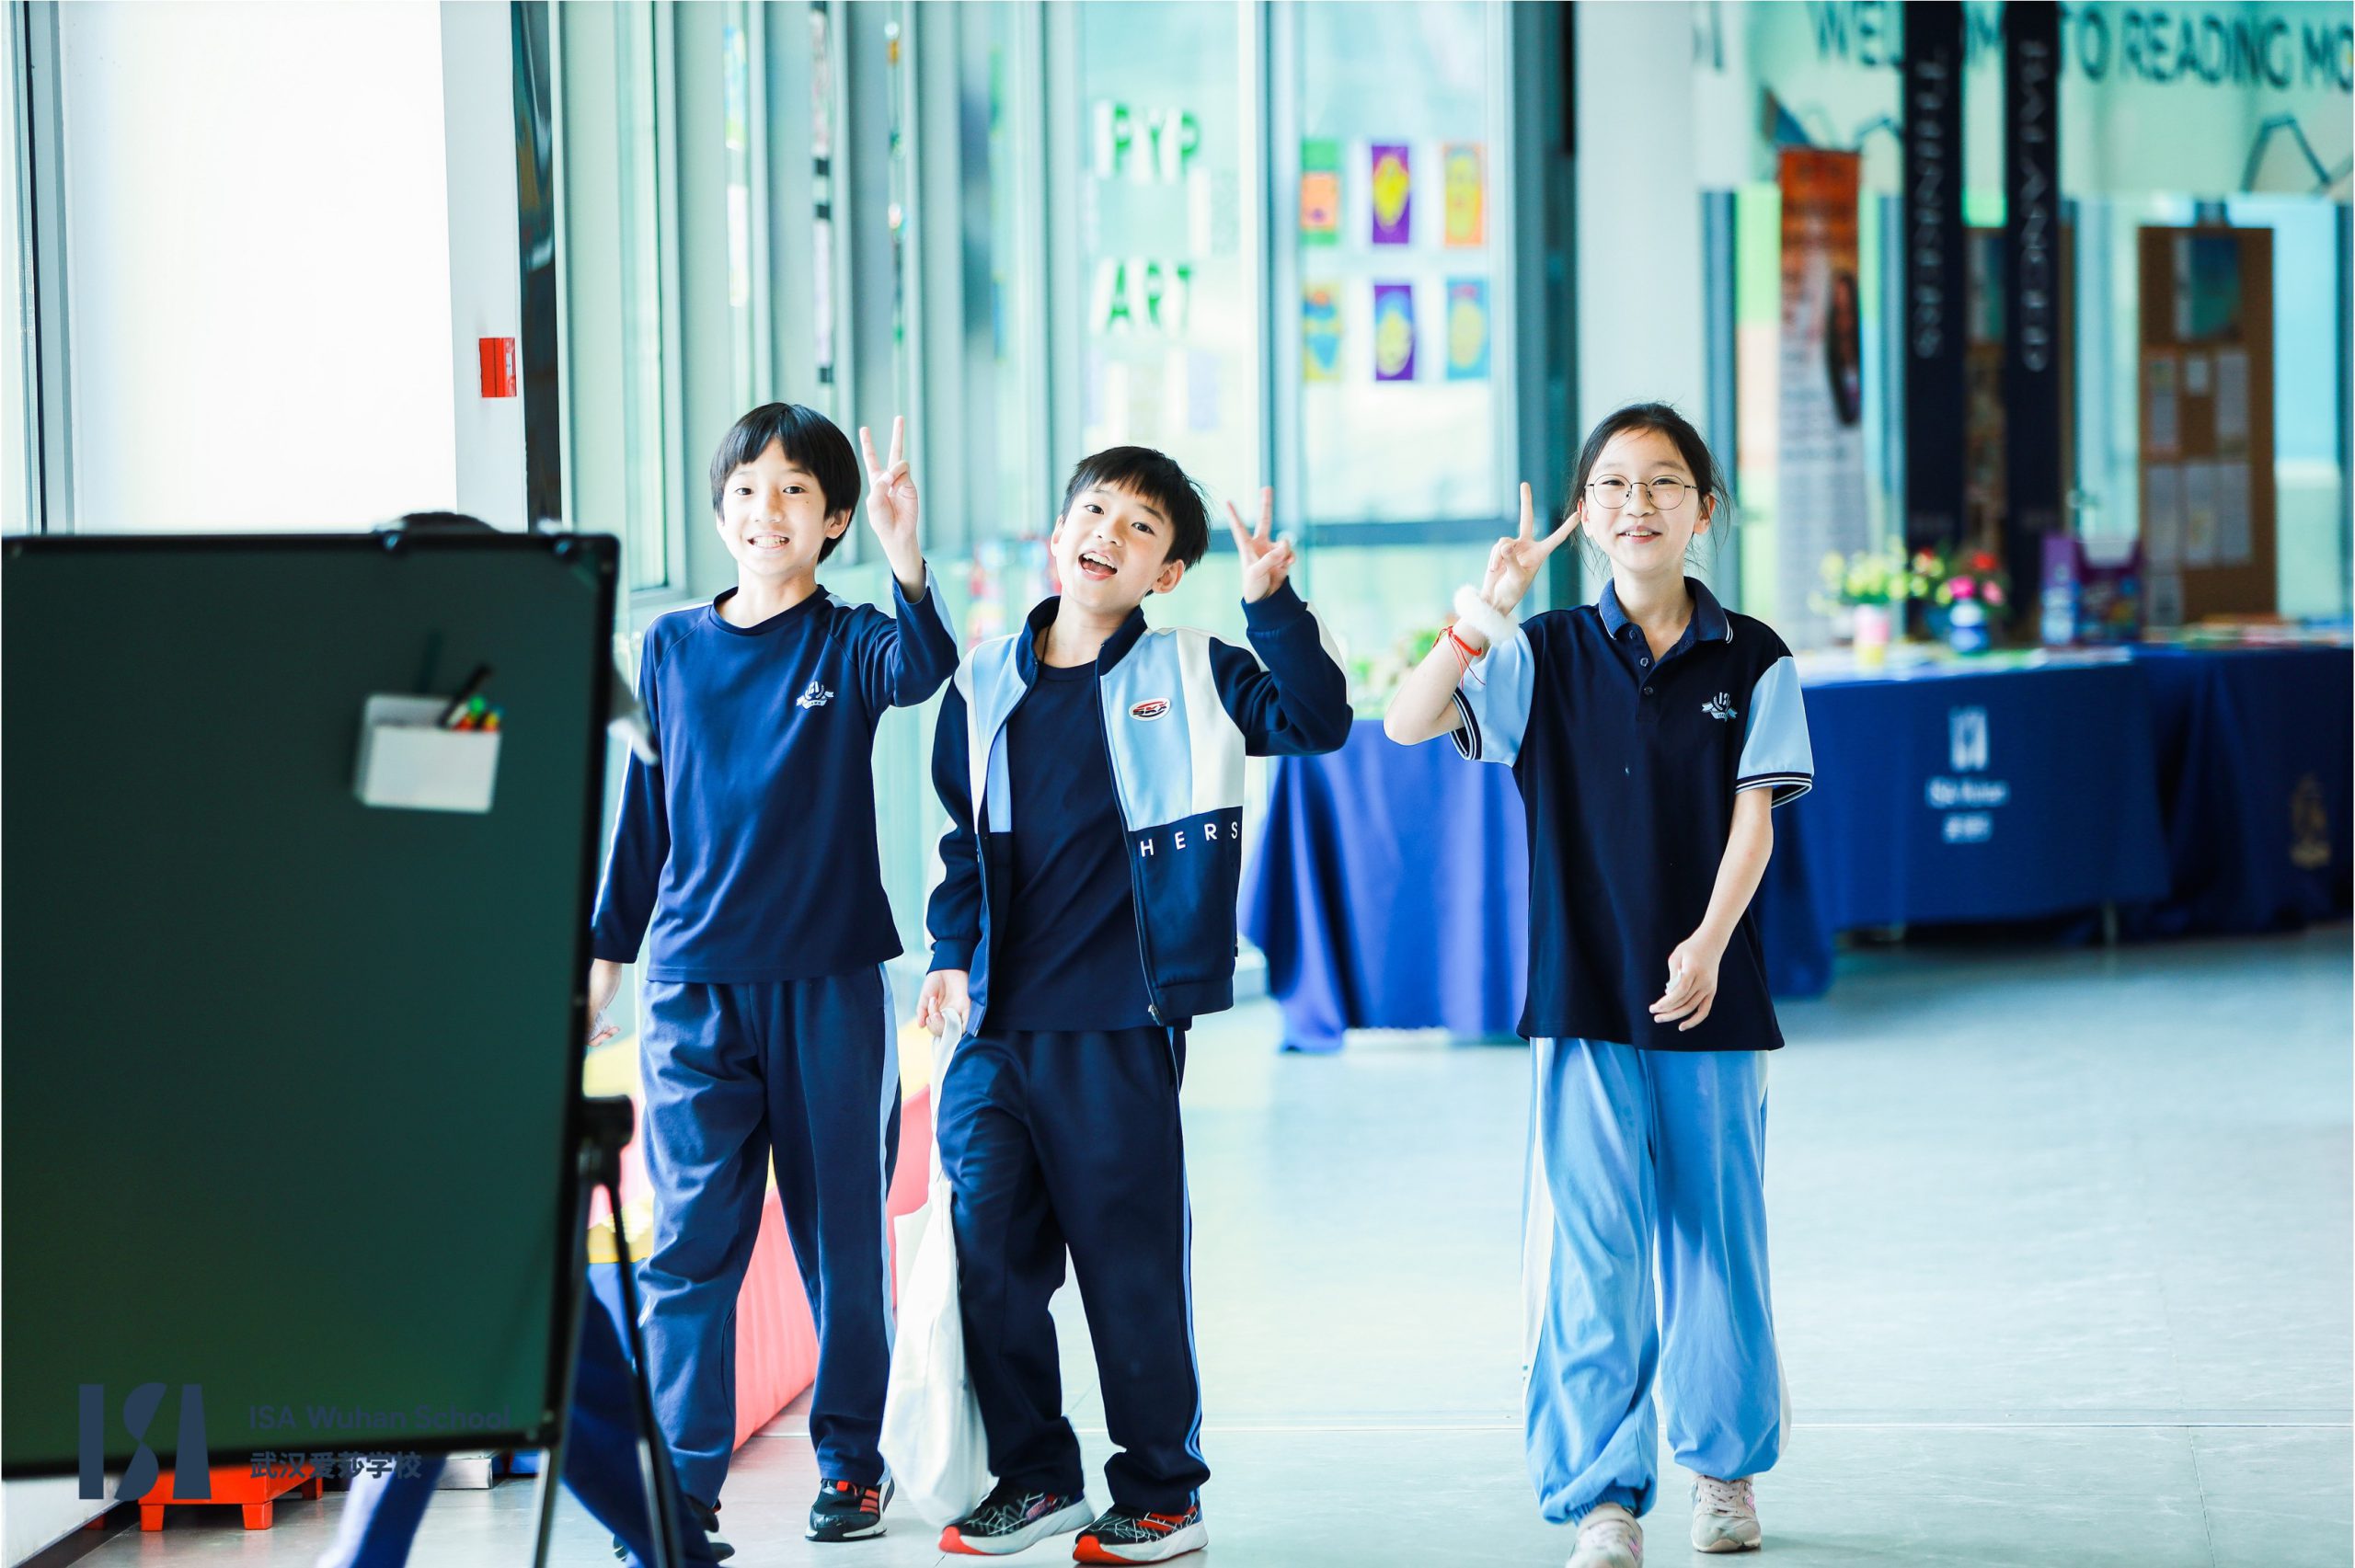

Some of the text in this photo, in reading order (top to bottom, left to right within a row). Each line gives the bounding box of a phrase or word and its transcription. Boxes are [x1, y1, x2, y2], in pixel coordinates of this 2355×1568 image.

[2120, 7, 2290, 89] READING
[1107, 103, 1201, 180] PYP
[1913, 46, 1950, 360] THINKERS
[2019, 40, 2050, 372] BALANCED
[1104, 260, 1193, 331] ART
[1140, 821, 1238, 857] HERS
